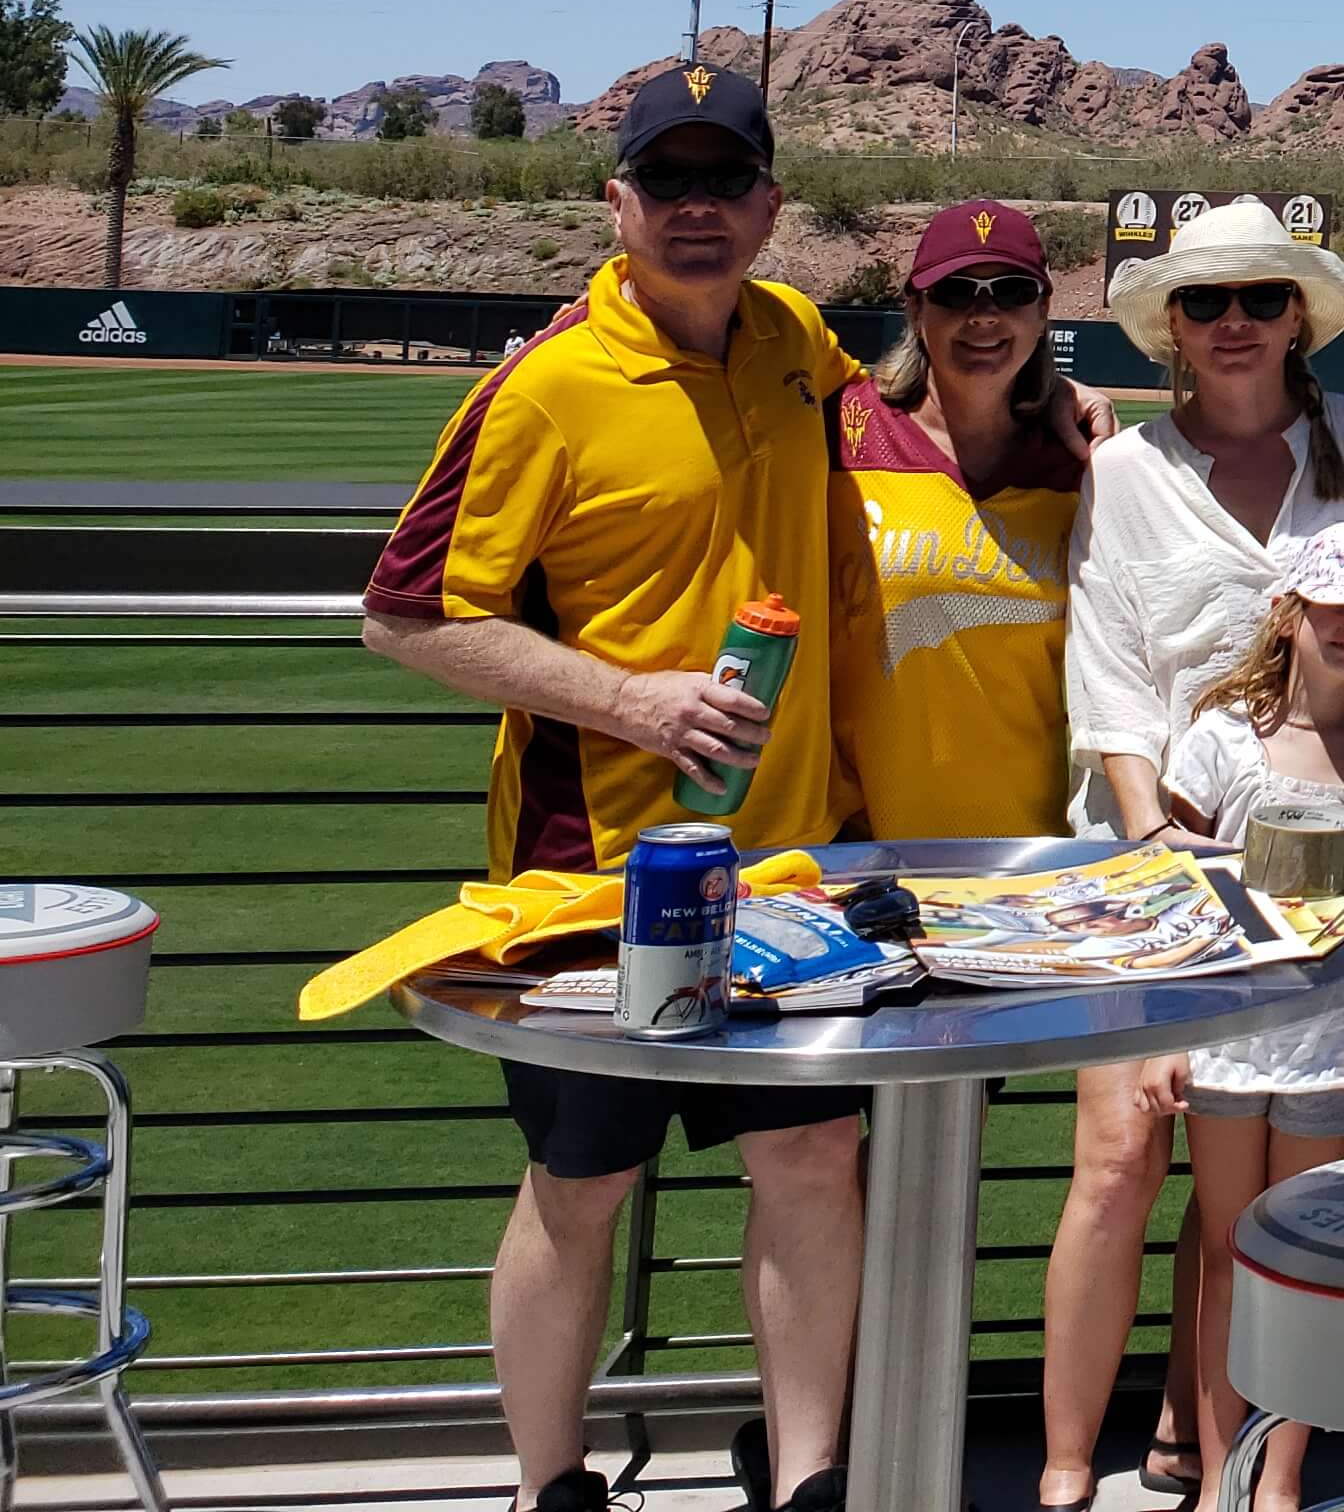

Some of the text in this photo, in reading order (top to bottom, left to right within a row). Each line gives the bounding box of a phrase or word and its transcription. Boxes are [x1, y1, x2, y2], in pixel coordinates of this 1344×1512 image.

[1130, 197, 1313, 224] 1 27 21
[78, 327, 147, 343] adidas
[661, 908, 697, 918] NEW
